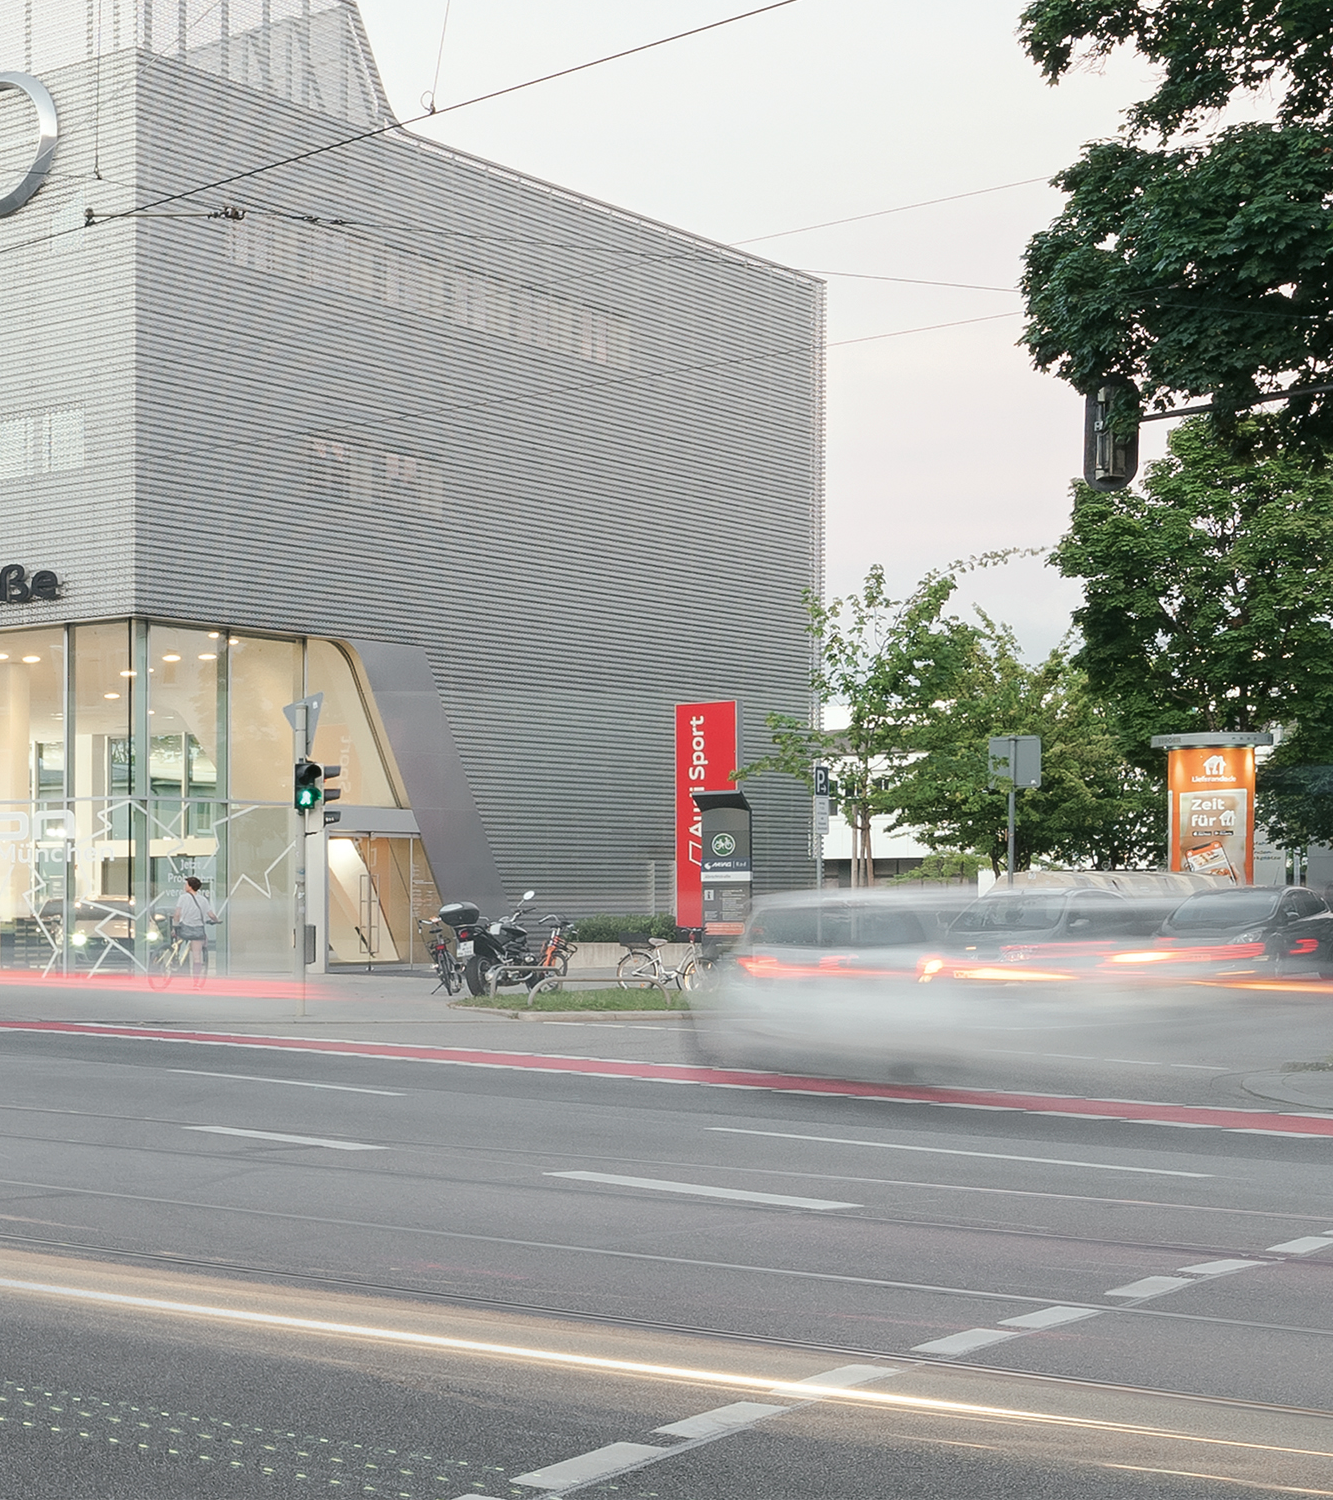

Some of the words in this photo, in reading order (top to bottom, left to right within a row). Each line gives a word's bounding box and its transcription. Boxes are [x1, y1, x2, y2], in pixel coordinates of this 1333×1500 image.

[689, 715, 709, 780] Sport
[817, 770, 825, 792] P
[688, 786, 704, 838] Aui
[1191, 798, 1225, 810] Zeit
[1191, 813, 1217, 827] für
